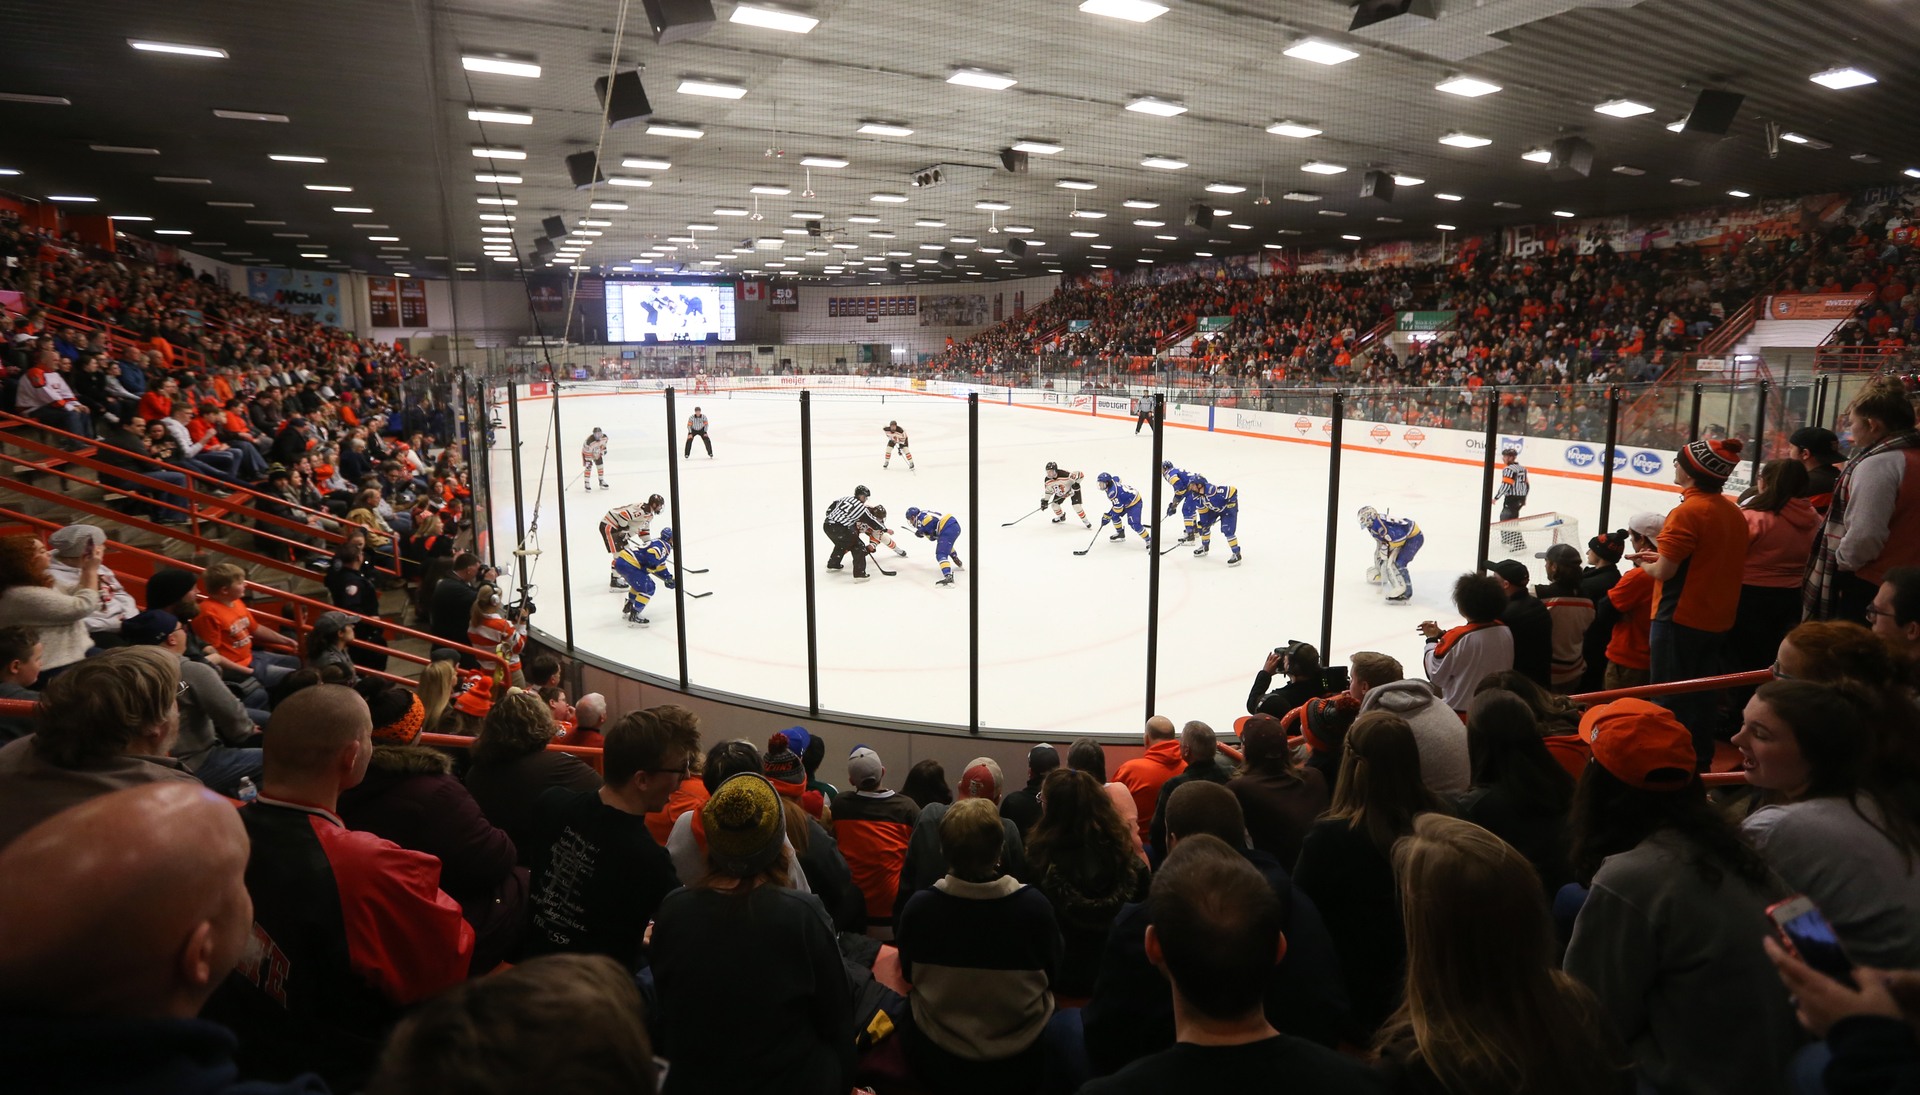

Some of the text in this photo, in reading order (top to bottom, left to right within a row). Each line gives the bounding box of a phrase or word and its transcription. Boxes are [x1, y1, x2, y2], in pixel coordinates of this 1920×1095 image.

[781, 377, 806, 386] meijer
[1098, 400, 1111, 408] BUD
[1110, 401, 1128, 411] LIGHT
[1567, 447, 1594, 465] Kroger
[1633, 454, 1661, 474] Kroger
